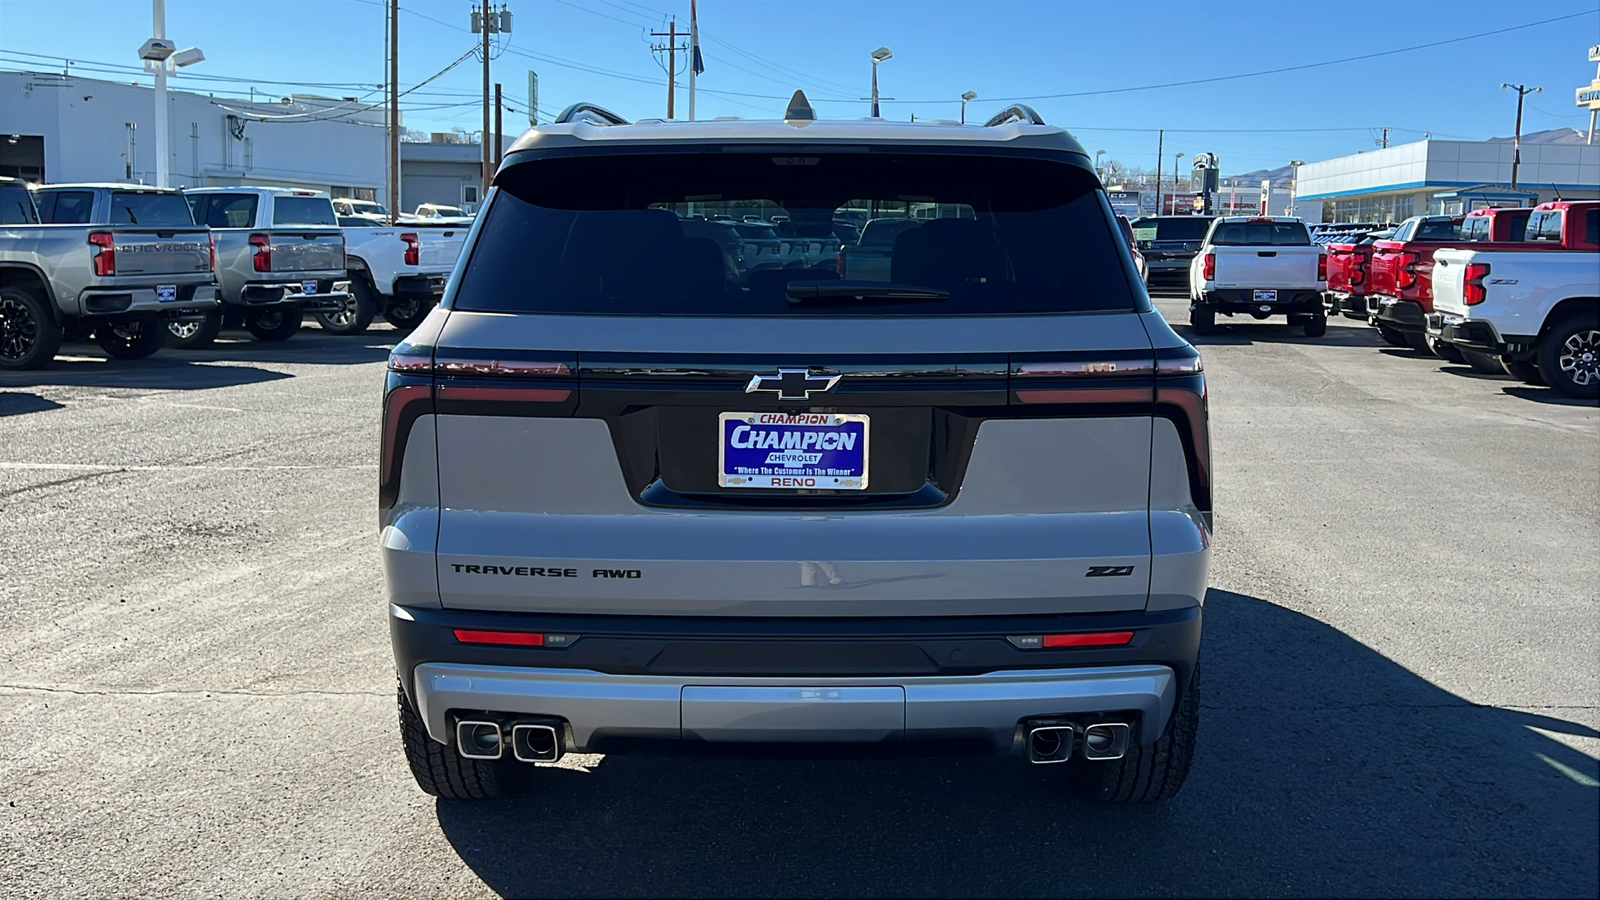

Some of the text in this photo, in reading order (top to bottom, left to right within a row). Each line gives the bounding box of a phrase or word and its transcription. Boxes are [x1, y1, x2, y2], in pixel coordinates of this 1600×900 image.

[760, 414, 829, 425] CHAMPION
[769, 454, 819, 463] CHEVROLET
[761, 467, 773, 475] The
[774, 467, 805, 476] Customer
[806, 467, 813, 476] Is
[814, 468, 826, 476] The
[771, 477, 816, 487] RENO
[451, 563, 642, 579] TRAVERSE AWD
